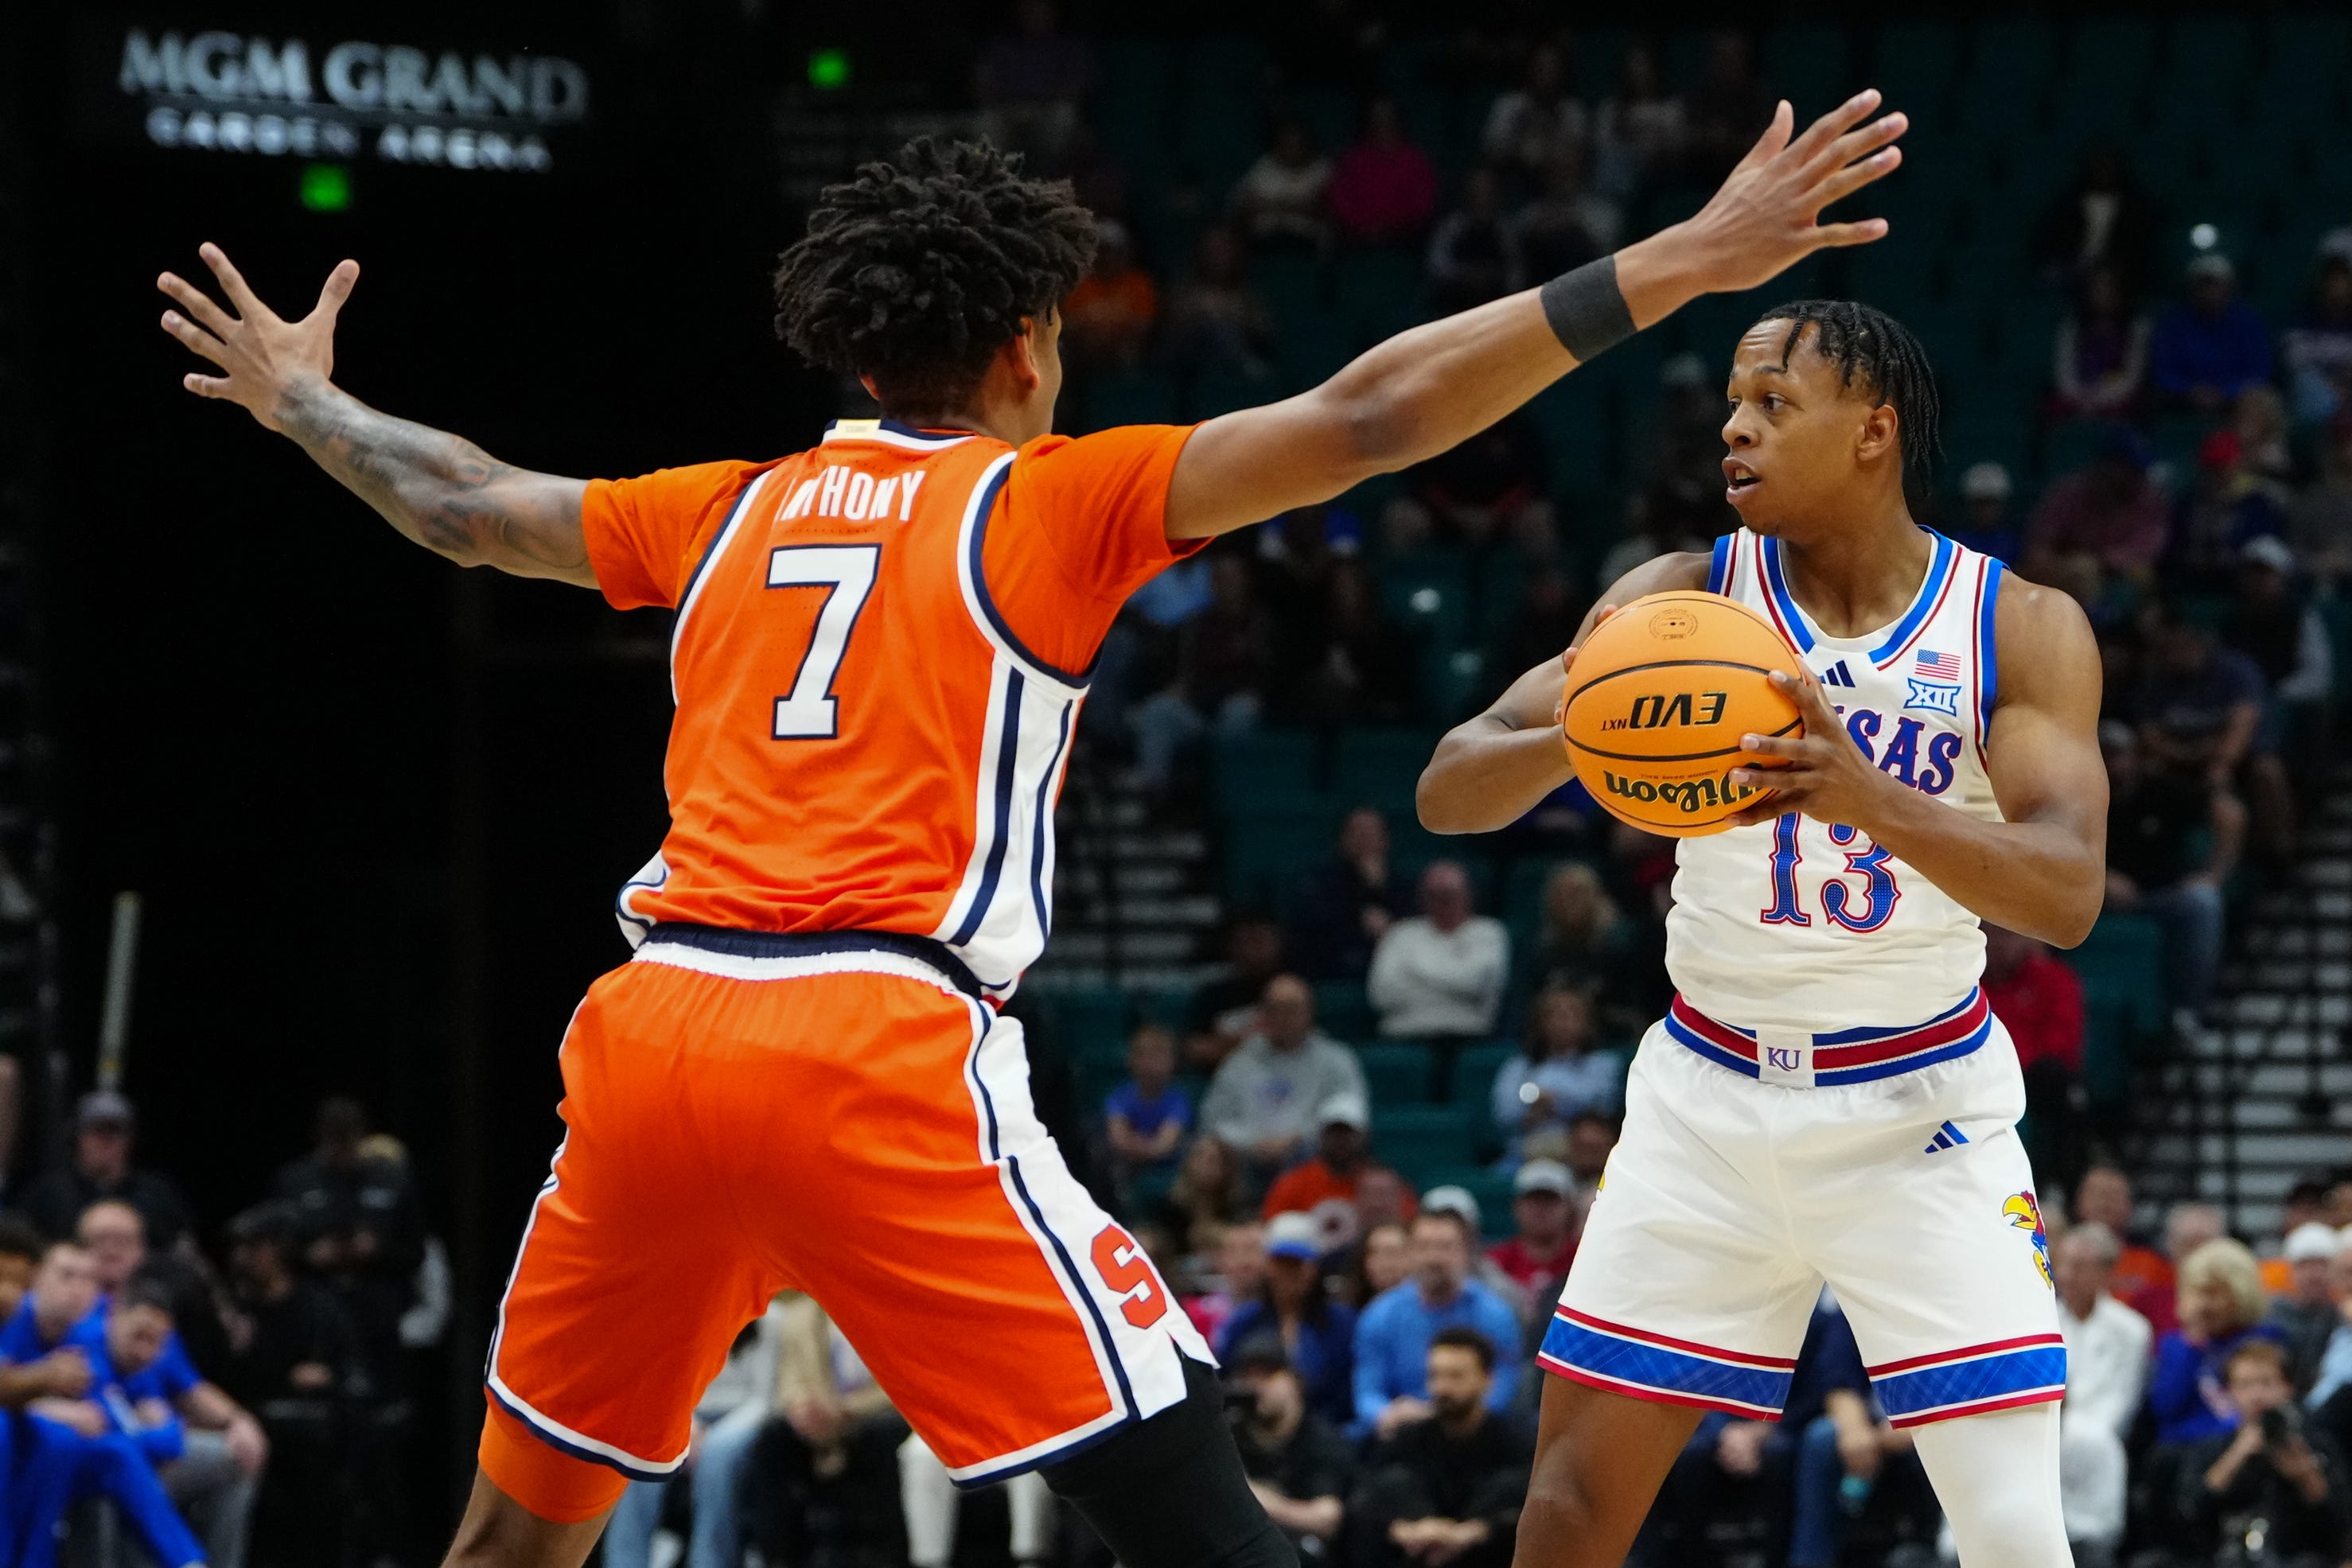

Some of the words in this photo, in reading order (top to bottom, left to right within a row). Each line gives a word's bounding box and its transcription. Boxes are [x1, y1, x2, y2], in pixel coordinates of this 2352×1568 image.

[121, 29, 310, 103] MGM
[324, 41, 587, 124] GRAND
[765, 543, 882, 741] 7
[1601, 718, 1628, 731] NXT
[1630, 691, 1727, 730] EVO
[1832, 705, 1963, 796] SAS
[1760, 811, 1902, 934] 13
[1766, 1046, 1801, 1072] KU
[1091, 1223, 1167, 1330] S
